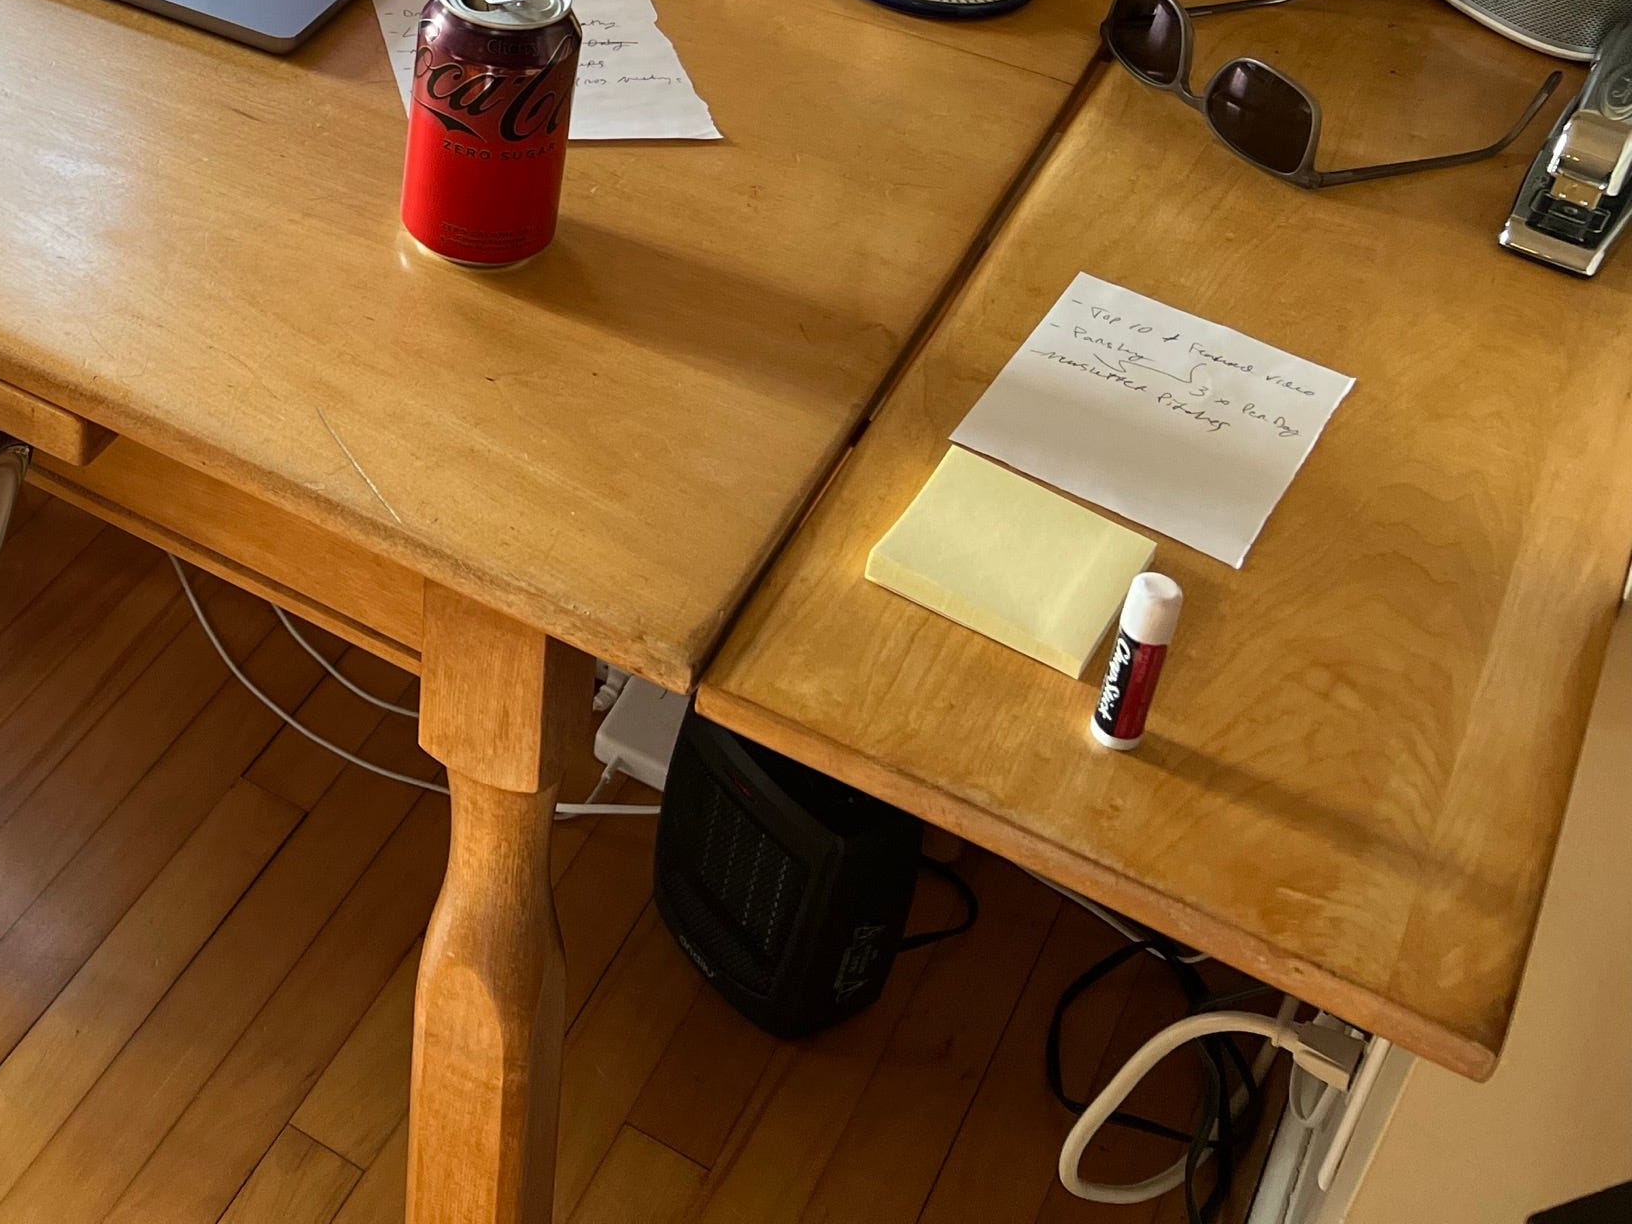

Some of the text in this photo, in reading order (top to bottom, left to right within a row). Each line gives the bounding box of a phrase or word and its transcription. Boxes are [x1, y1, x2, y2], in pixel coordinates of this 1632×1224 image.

[442, 139, 556, 161] ZERO SUGAR
[1091, 306, 1122, 325] Top
[1129, 324, 1153, 334] 10
